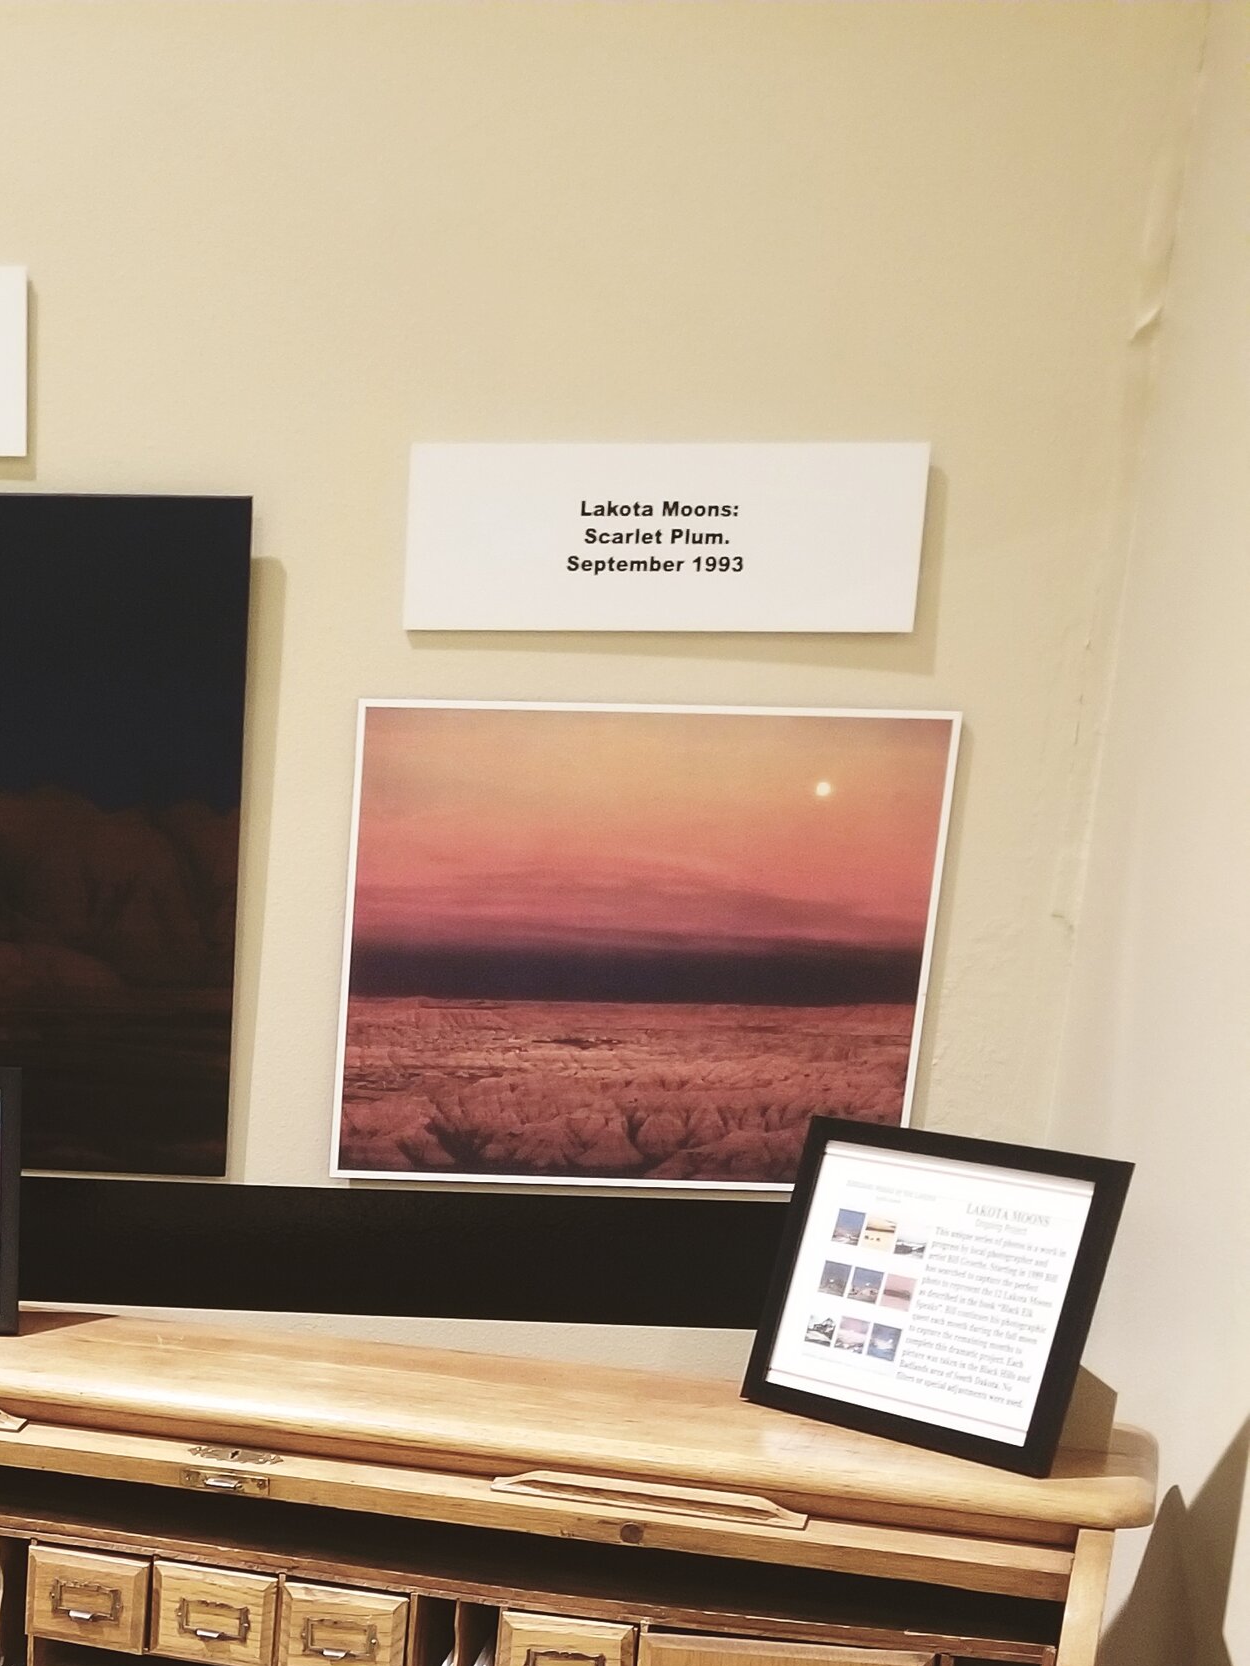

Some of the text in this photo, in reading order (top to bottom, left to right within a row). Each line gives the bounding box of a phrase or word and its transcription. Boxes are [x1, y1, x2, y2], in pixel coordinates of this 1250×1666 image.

[580, 500, 739, 518] Lakota Moons:
[584, 527, 730, 545] Scarlet Plum.
[566, 555, 744, 576] September 1993
[965, 1203, 1051, 1227] LAKOTA MOONS
